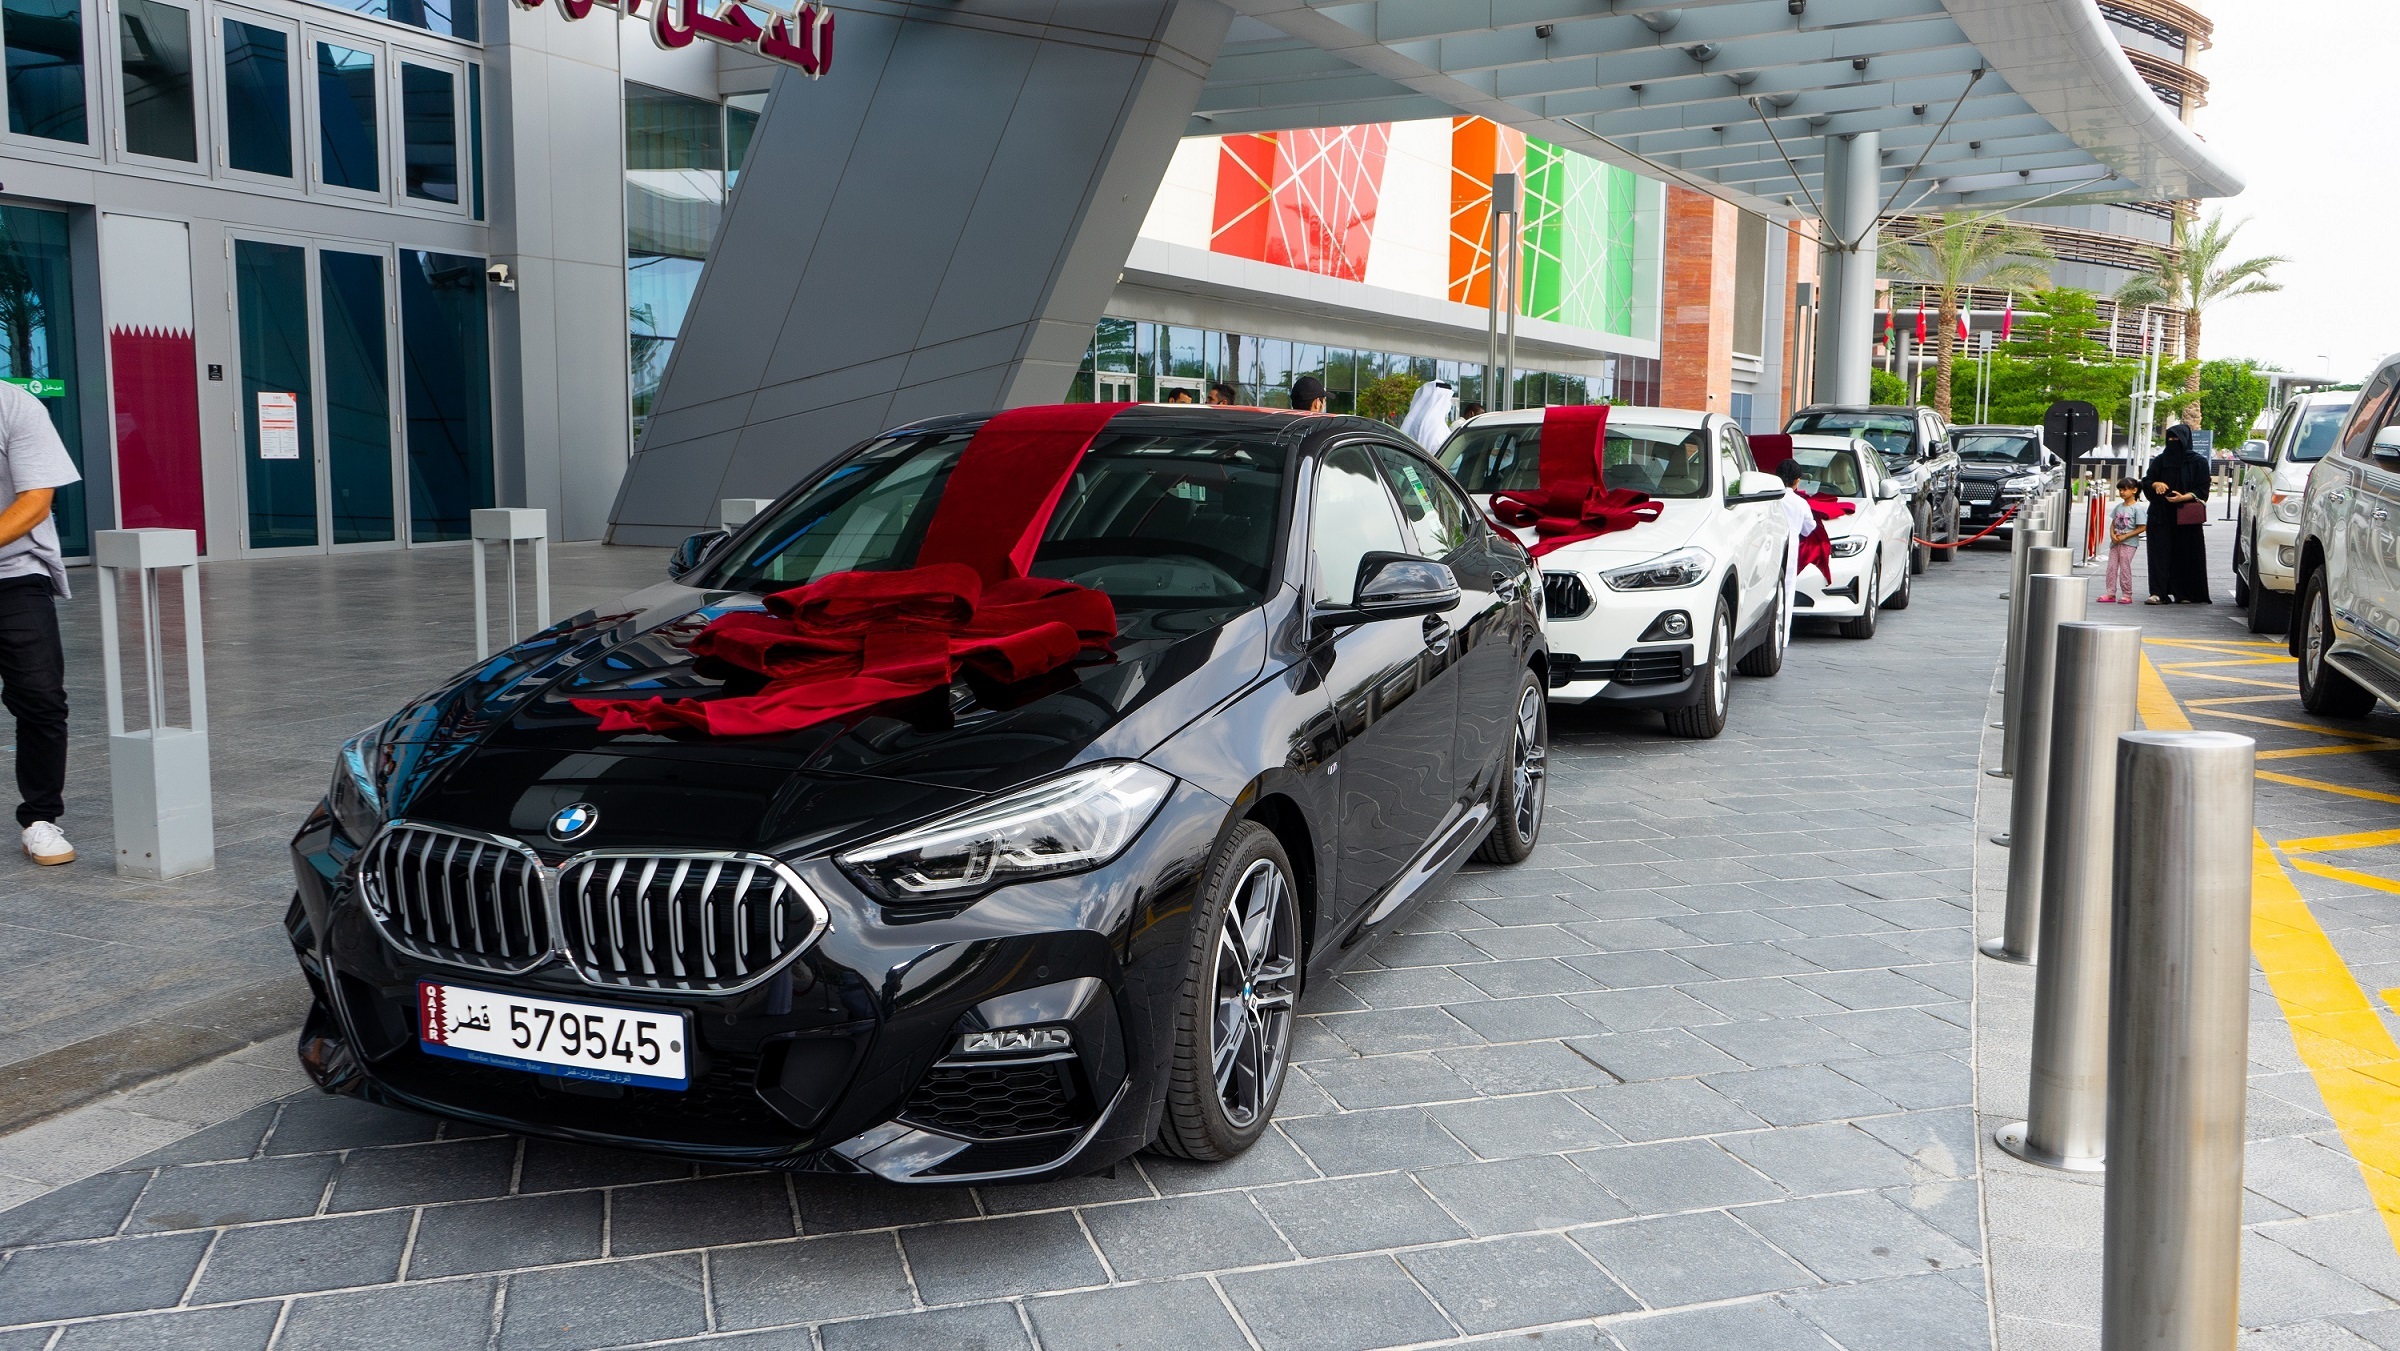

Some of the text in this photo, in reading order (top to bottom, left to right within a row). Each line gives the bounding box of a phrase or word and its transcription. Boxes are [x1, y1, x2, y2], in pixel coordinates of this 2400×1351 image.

[425, 985, 439, 1041] QATAR
[448, 1004, 491, 1034] قطر
[510, 1004, 660, 1066] 579545
